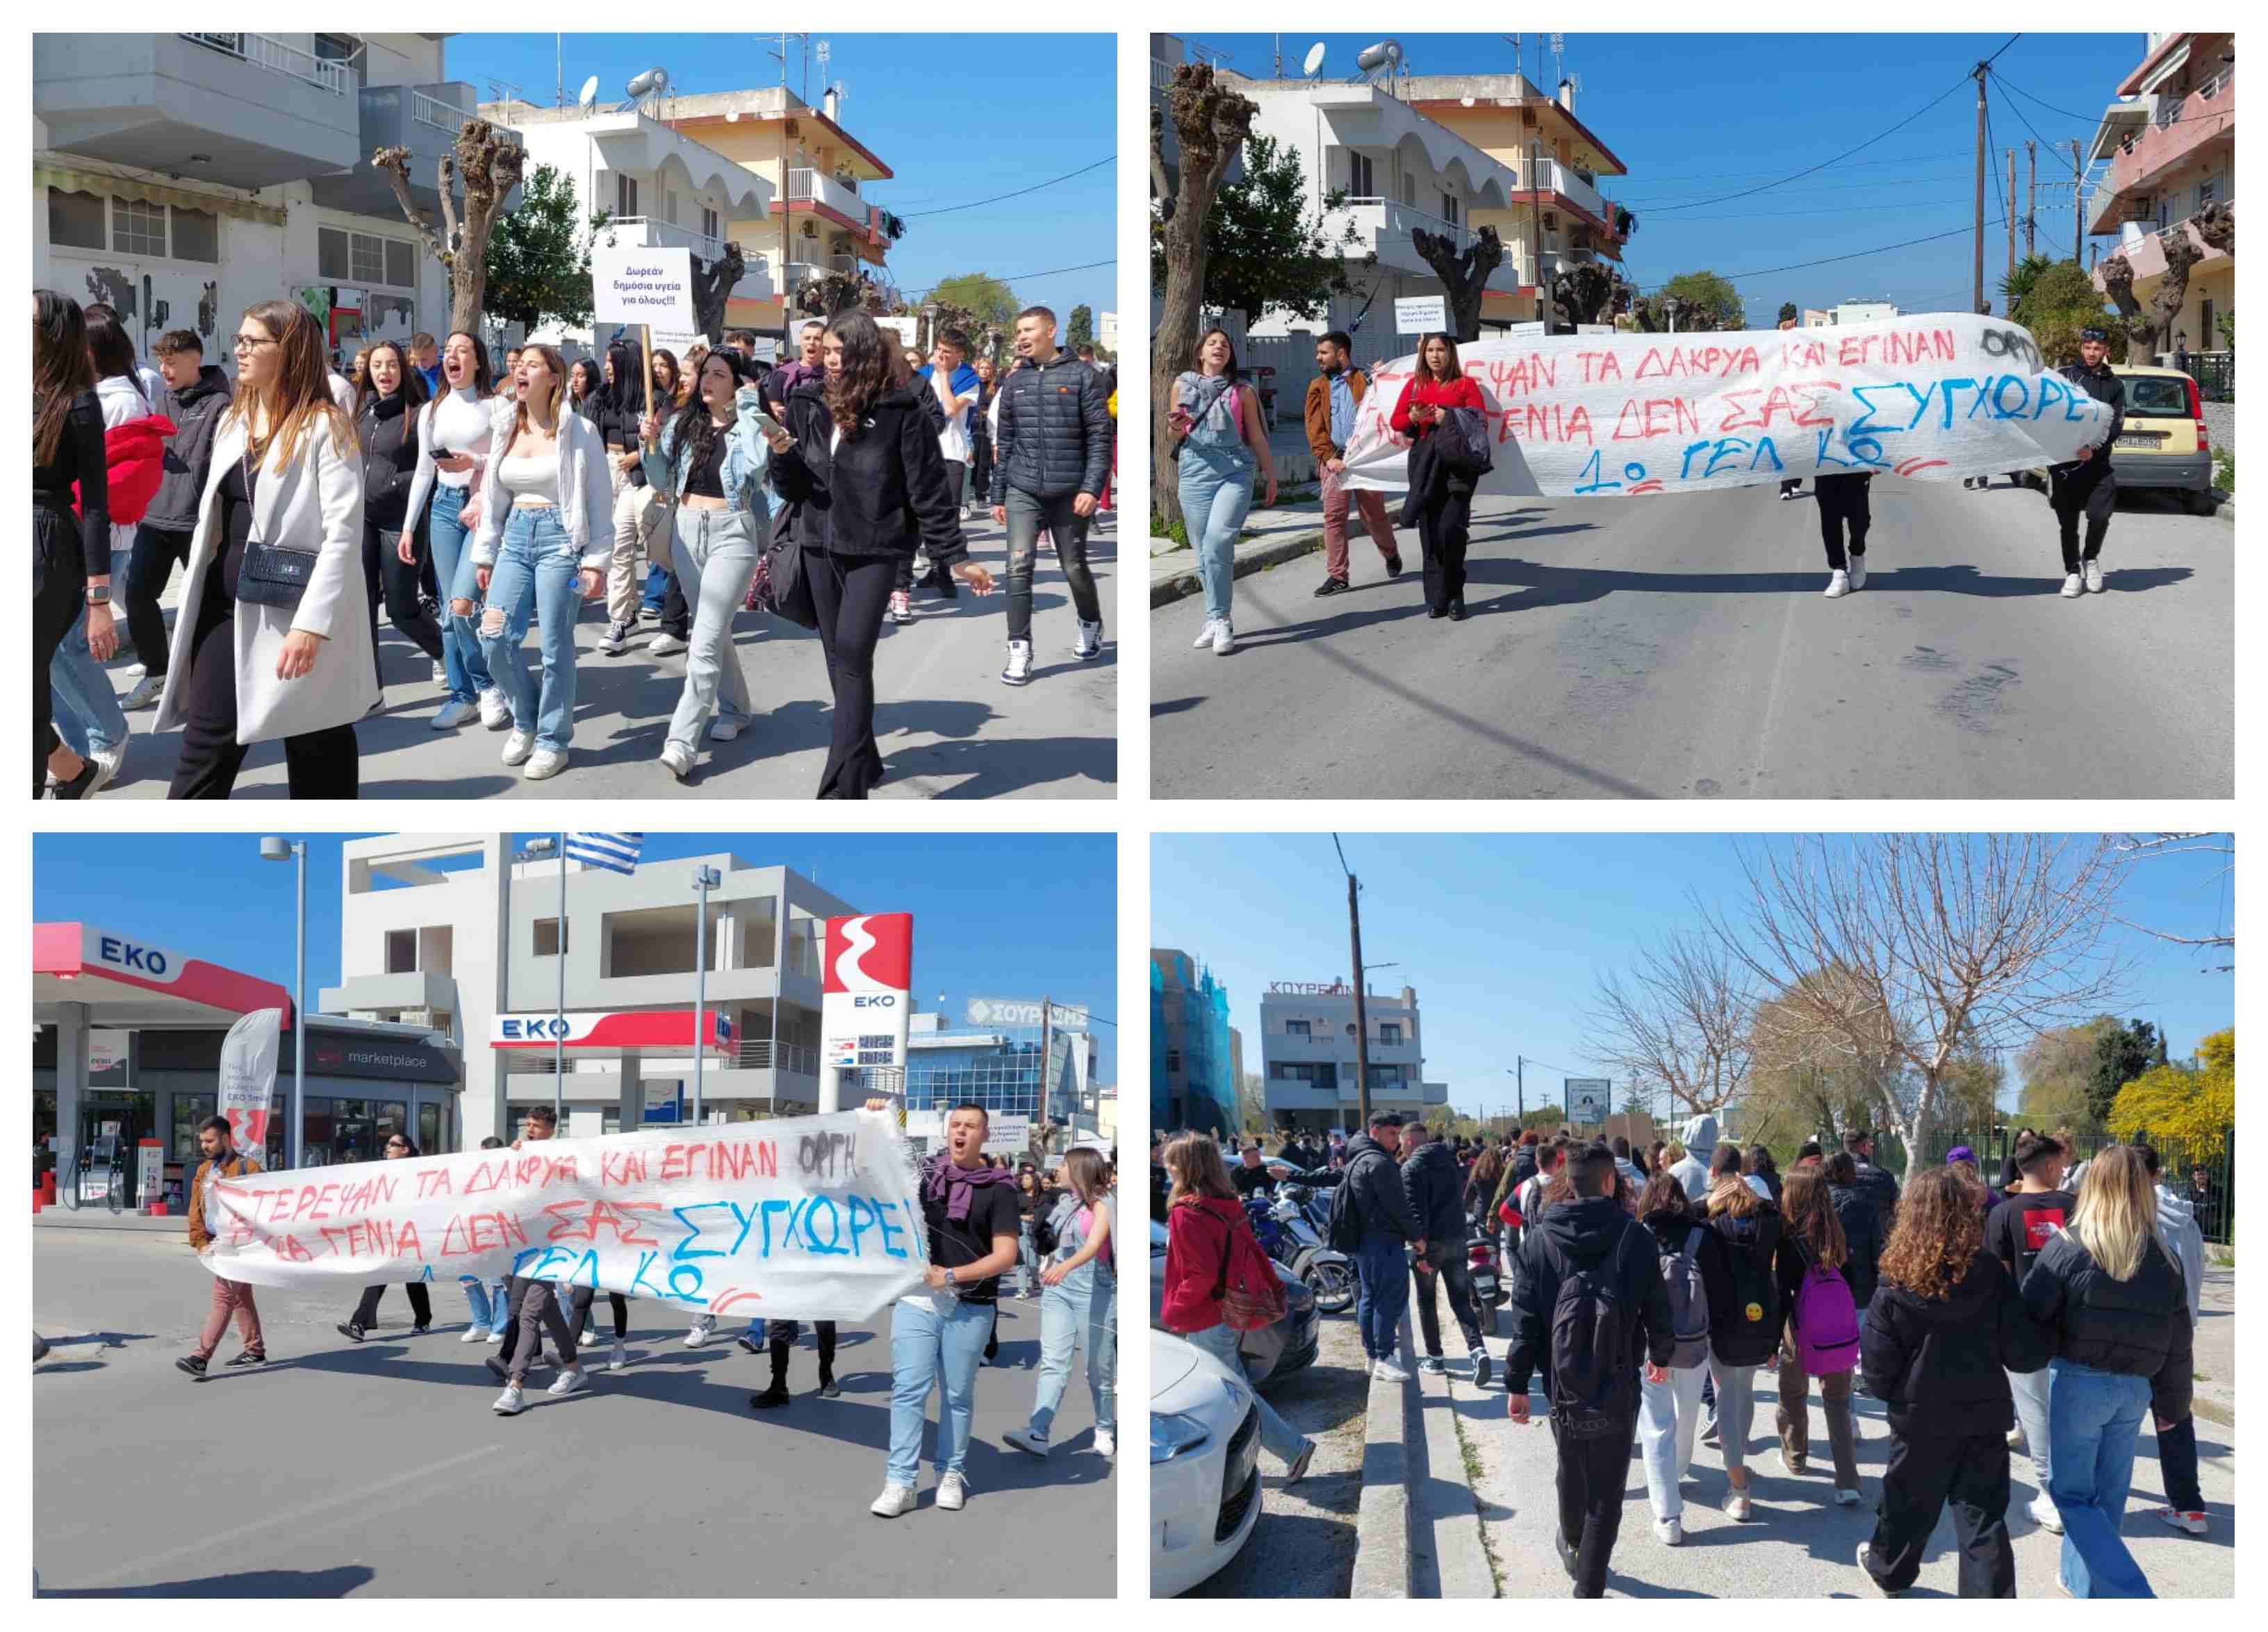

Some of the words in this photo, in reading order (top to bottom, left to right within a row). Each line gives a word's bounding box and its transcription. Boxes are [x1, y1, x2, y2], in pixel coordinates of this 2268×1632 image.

[625, 264, 663, 277] Δωρεάν
[613, 279, 653, 292] δημόσια
[655, 279, 681, 292] υγεία
[622, 297, 636, 306] για
[1576, 351, 1622, 383] ΤΑ
[1634, 347, 1761, 379] ΔΑΚΡΥΑ
[1780, 342, 1827, 368] ΚΑΙ
[1839, 329, 1956, 367] ΕΓΙΝΑΝ
[1612, 395, 1700, 440] ΔΕΝ
[1719, 381, 1842, 432] ΣΑΣ
[1680, 436, 1784, 479] ΓΕΛ
[101, 937, 167, 975] EKO
[854, 995, 896, 1007] EKO
[502, 1019, 570, 1039] EKO
[349, 1051, 427, 1068] marketplace
[416, 1167, 452, 1198] ΤΑ
[463, 1155, 579, 1194] ΔΑΚΡΥΑ
[601, 1150, 649, 1187] ΚΑΙ
[660, 1141, 777, 1179] ΕΓΙΝΑΝ
[798, 1130, 860, 1178] ΟΡΓΗ
[318, 1218, 424, 1262] ΓΕΝΙΑ
[441, 1211, 529, 1257] ΔΕΝ
[544, 1200, 663, 1246] ΣΑΣ
[673, 1193, 923, 1260] ΣΥΓΧΩΡΕΙ
